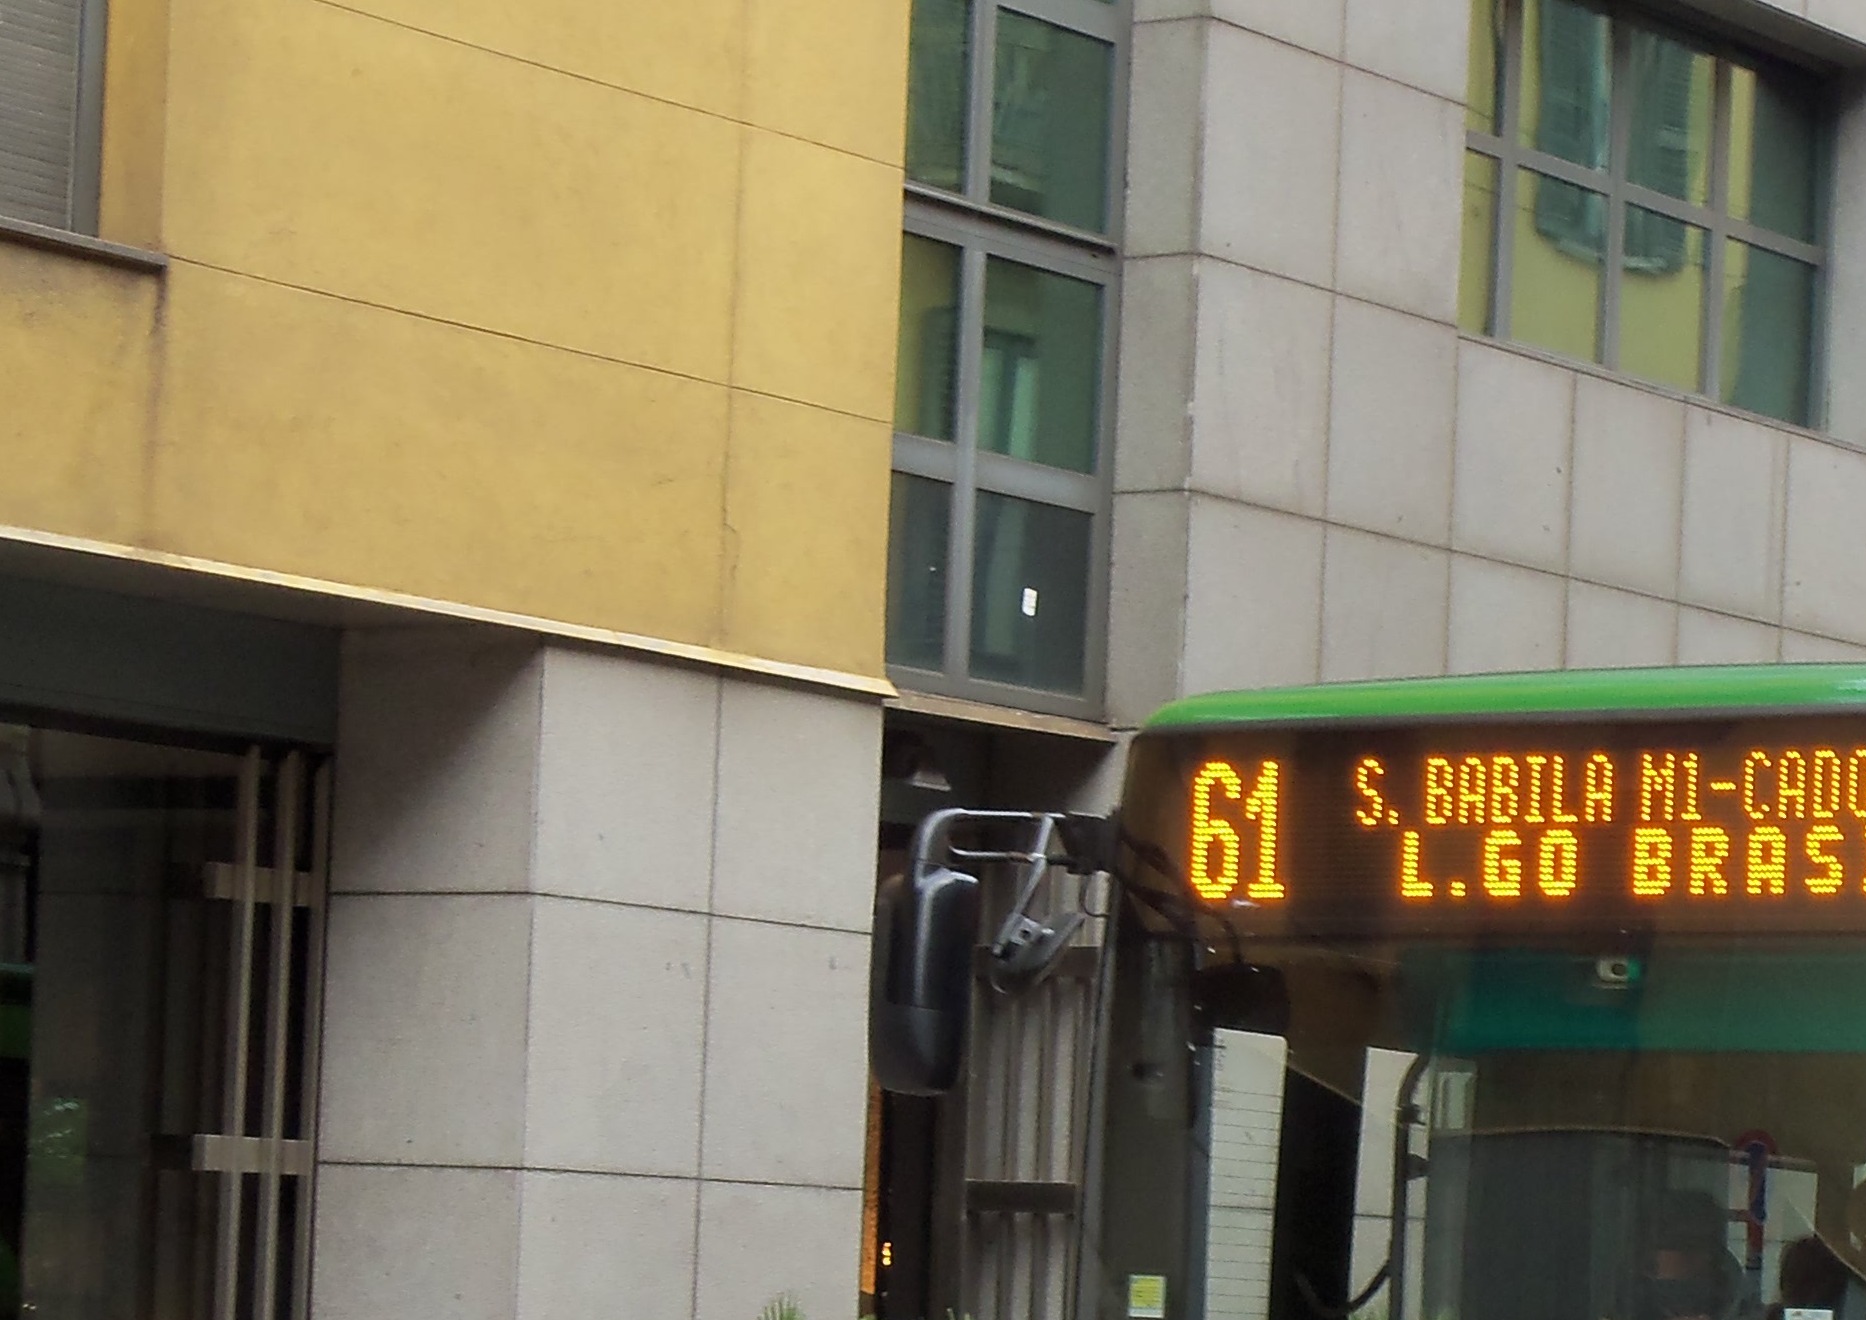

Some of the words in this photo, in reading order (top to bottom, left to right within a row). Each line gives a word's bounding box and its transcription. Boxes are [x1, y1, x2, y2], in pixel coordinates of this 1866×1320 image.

[1356, 759, 1399, 826] S.
[1424, 753, 1614, 825] BABILA
[1190, 760, 1285, 899] 61
[1400, 828, 1578, 898] L.GO
